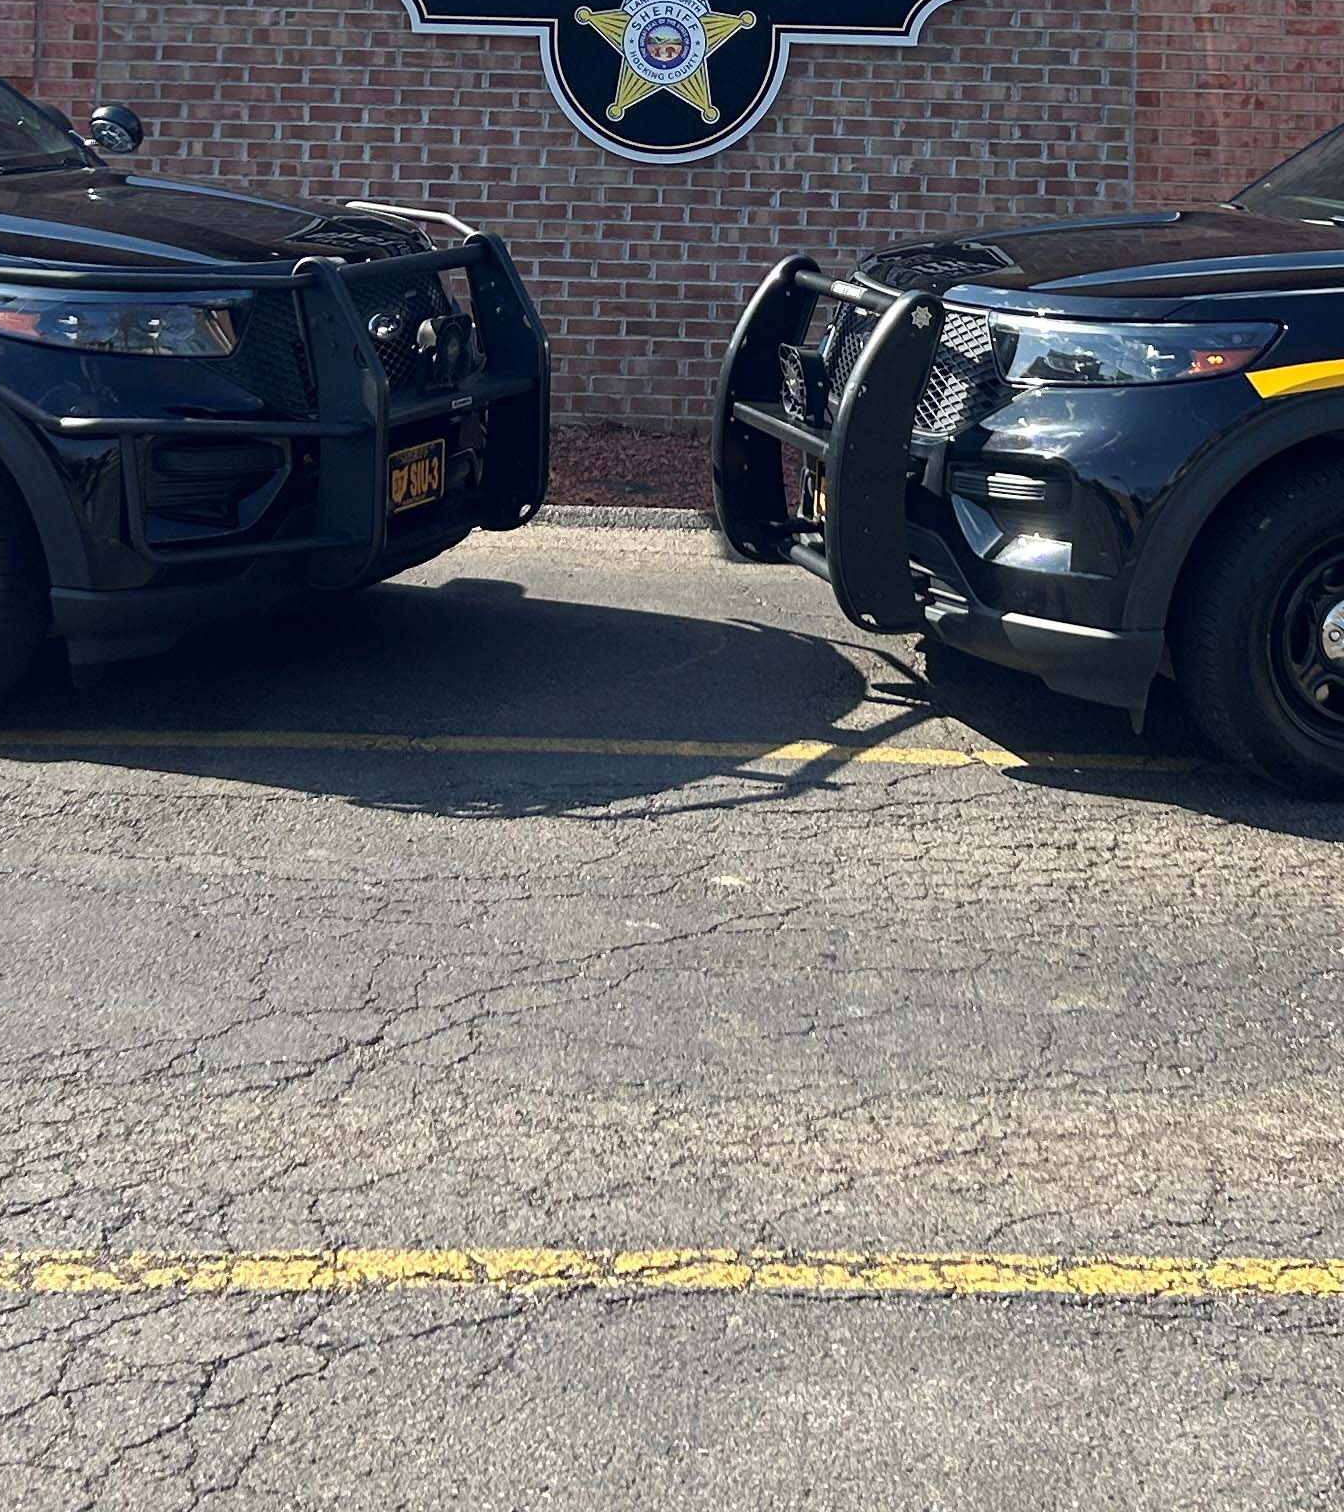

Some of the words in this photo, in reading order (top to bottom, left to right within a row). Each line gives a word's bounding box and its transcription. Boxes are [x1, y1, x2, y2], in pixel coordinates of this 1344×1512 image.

[631, 5, 700, 32] SHERIFF
[629, 51, 665, 80] HOCKING
[667, 53, 698, 80] COUNTY
[410, 456, 439, 497] SIU-3
